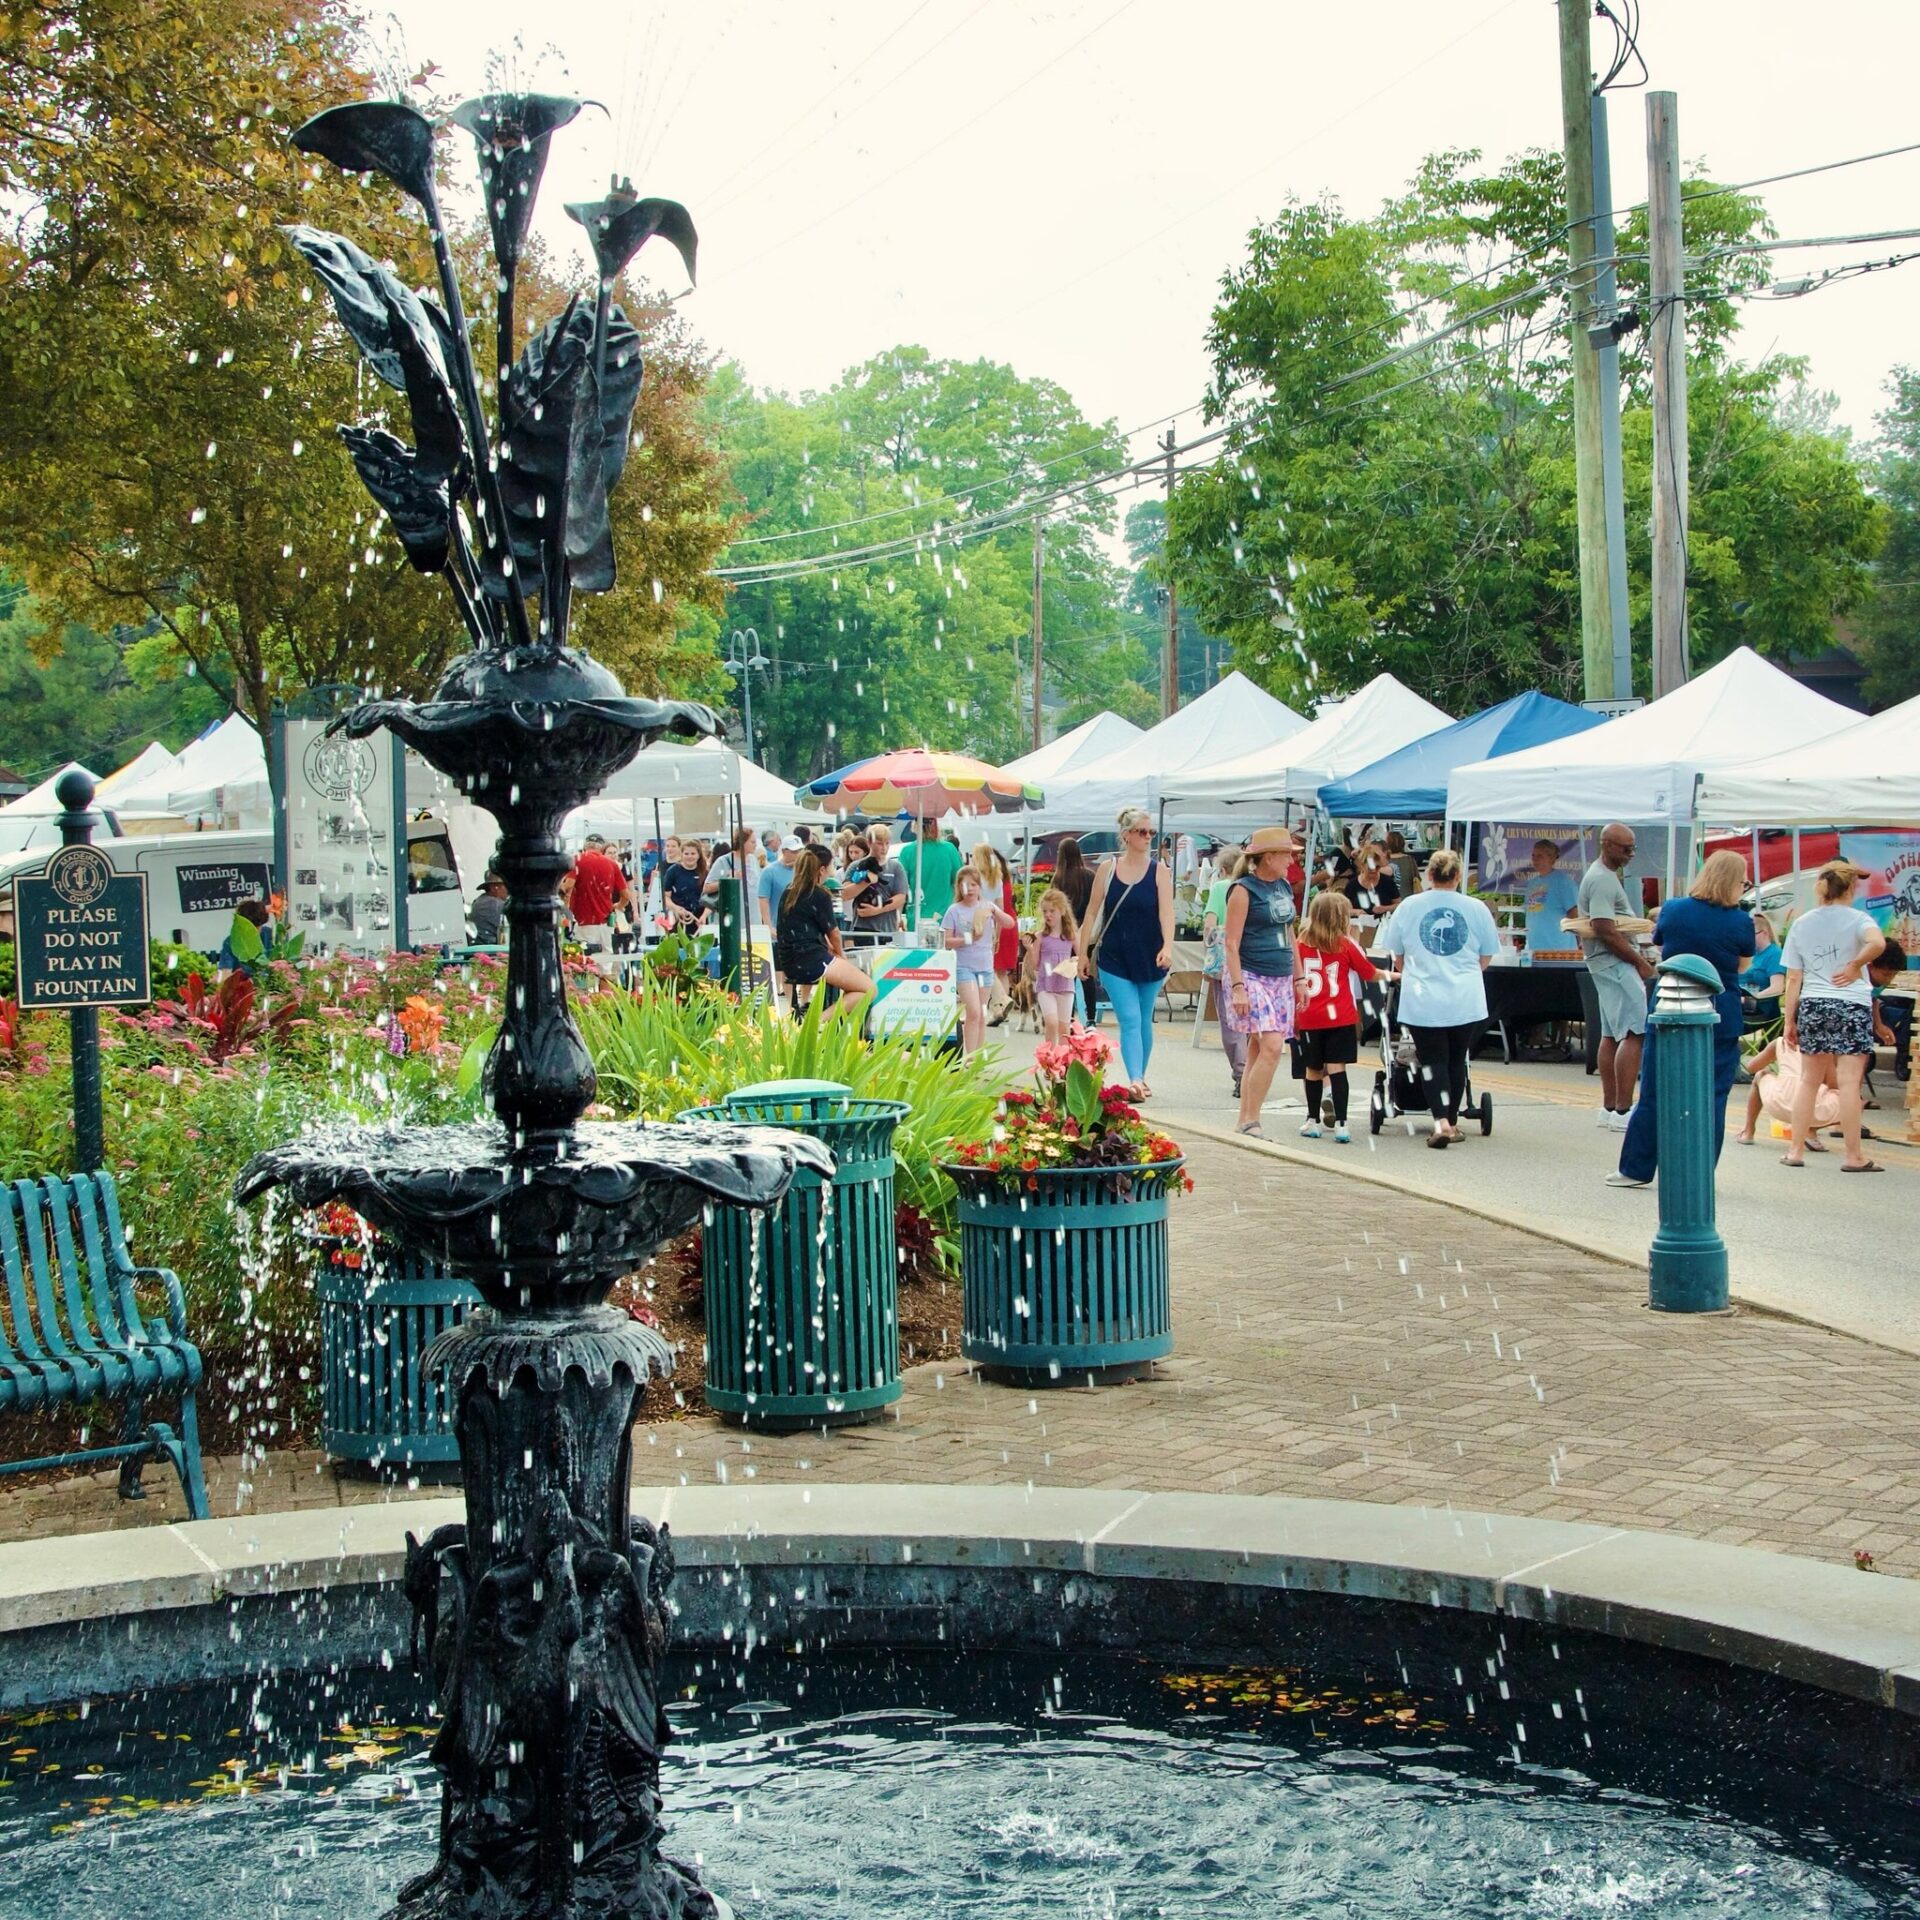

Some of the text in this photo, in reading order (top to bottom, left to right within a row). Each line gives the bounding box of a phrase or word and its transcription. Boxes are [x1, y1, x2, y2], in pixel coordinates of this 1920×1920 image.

[60, 853, 99, 866] MADEIRA
[179, 867, 239, 881] Winning
[228, 879, 260, 894] Edge
[69, 894, 93, 903] OHIO
[47, 908, 117, 924] PLEASE
[44, 931, 122, 948] DO NOT
[47, 955, 122, 971] PLAY IN
[1303, 957, 1339, 998] 51
[34, 978, 136, 996] FOUNTAIN
